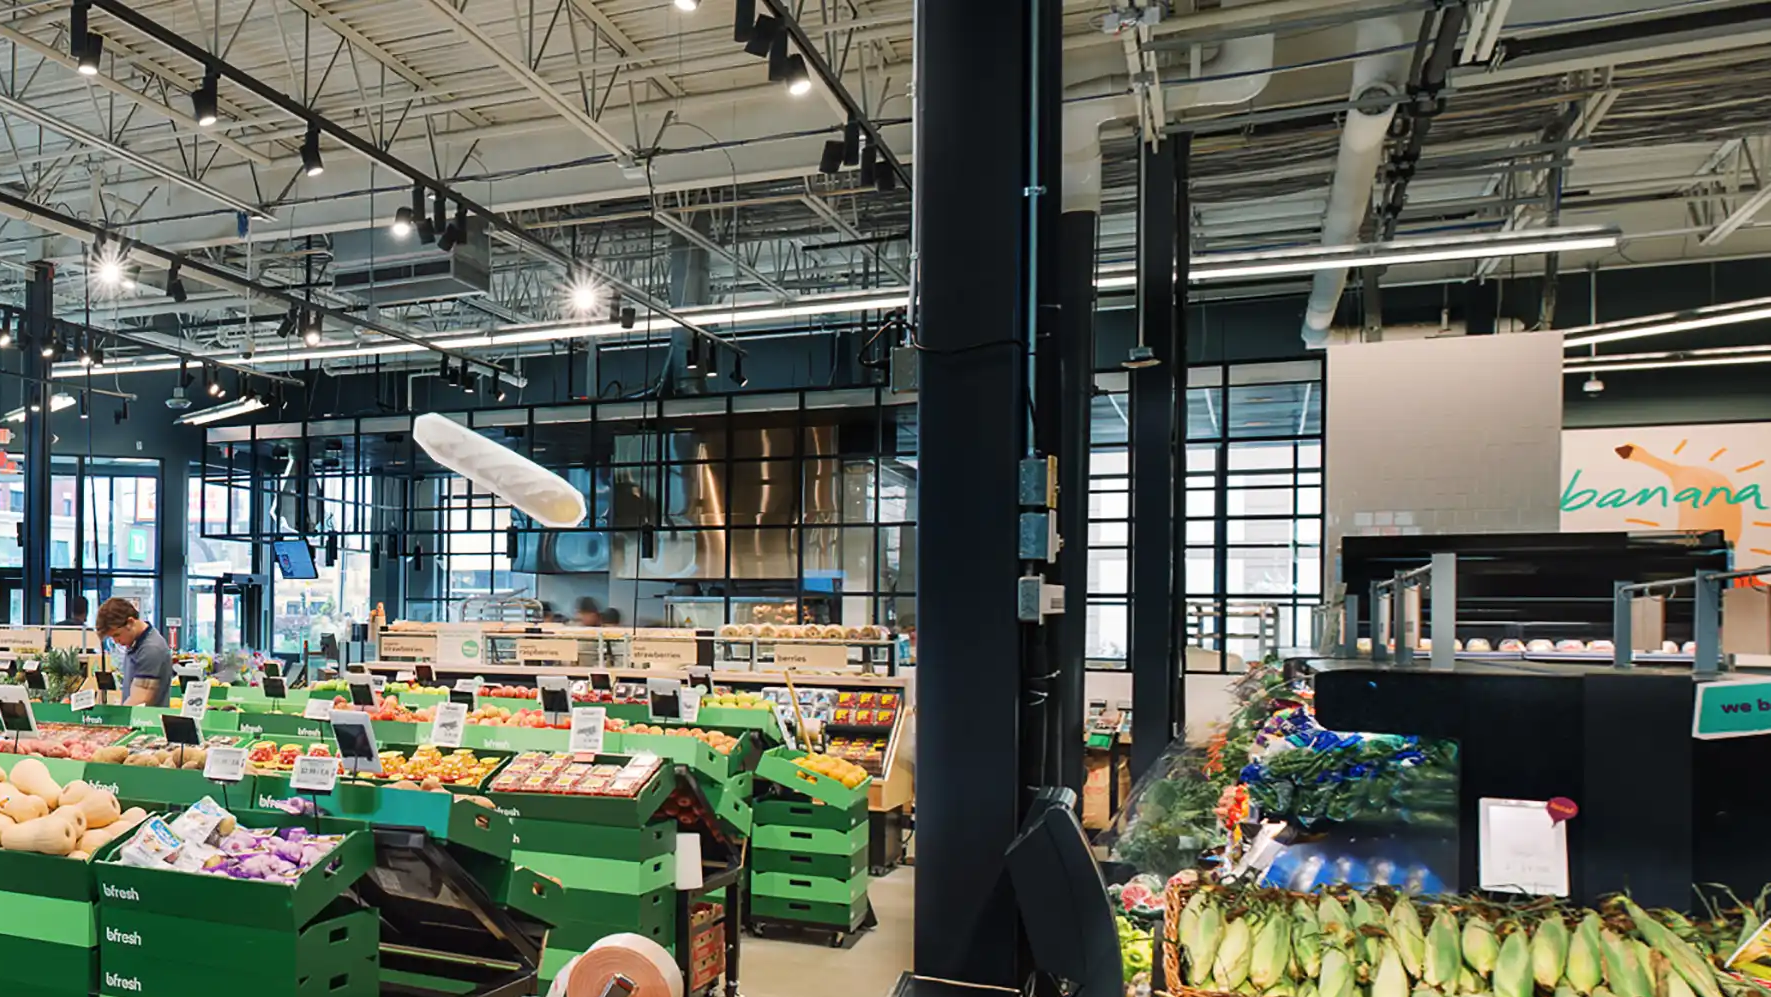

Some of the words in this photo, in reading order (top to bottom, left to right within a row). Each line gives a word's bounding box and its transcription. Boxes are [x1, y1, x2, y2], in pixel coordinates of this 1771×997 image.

[1559, 468, 1770, 513] banana
[634, 651, 681, 660] strawberries
[777, 653, 807, 663] berries
[1721, 700, 1752, 714] we
[103, 883, 140, 901] bfresh
[106, 926, 142, 946] bfresh
[106, 971, 142, 991] bfresh
